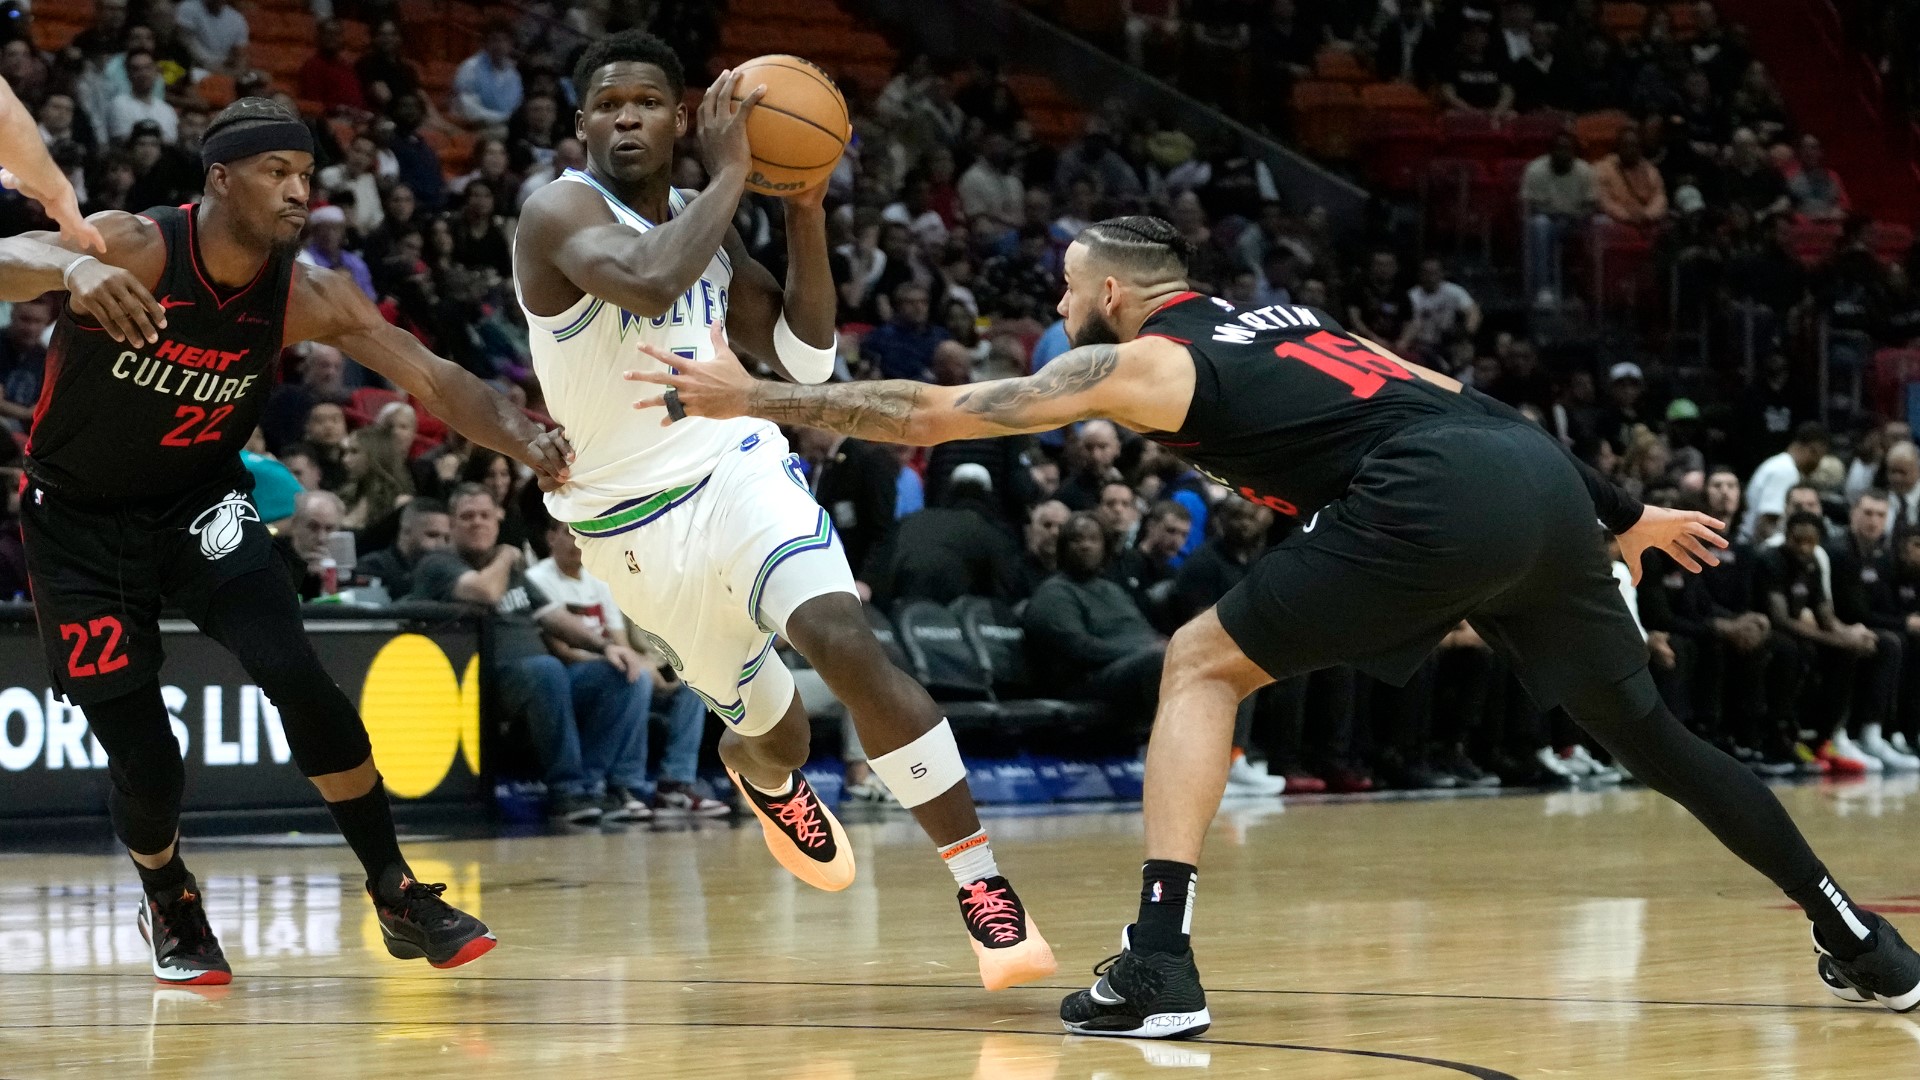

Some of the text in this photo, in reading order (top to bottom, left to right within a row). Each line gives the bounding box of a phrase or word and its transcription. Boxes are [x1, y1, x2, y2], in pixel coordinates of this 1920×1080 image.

[1211, 304, 1321, 345] MRTIN
[111, 350, 259, 403] CULTURE
[155, 339, 249, 372] HEAT
[1274, 329, 1416, 399] 16
[160, 404, 235, 447] 22
[60, 616, 129, 678] 22
[910, 762, 928, 780] 5
